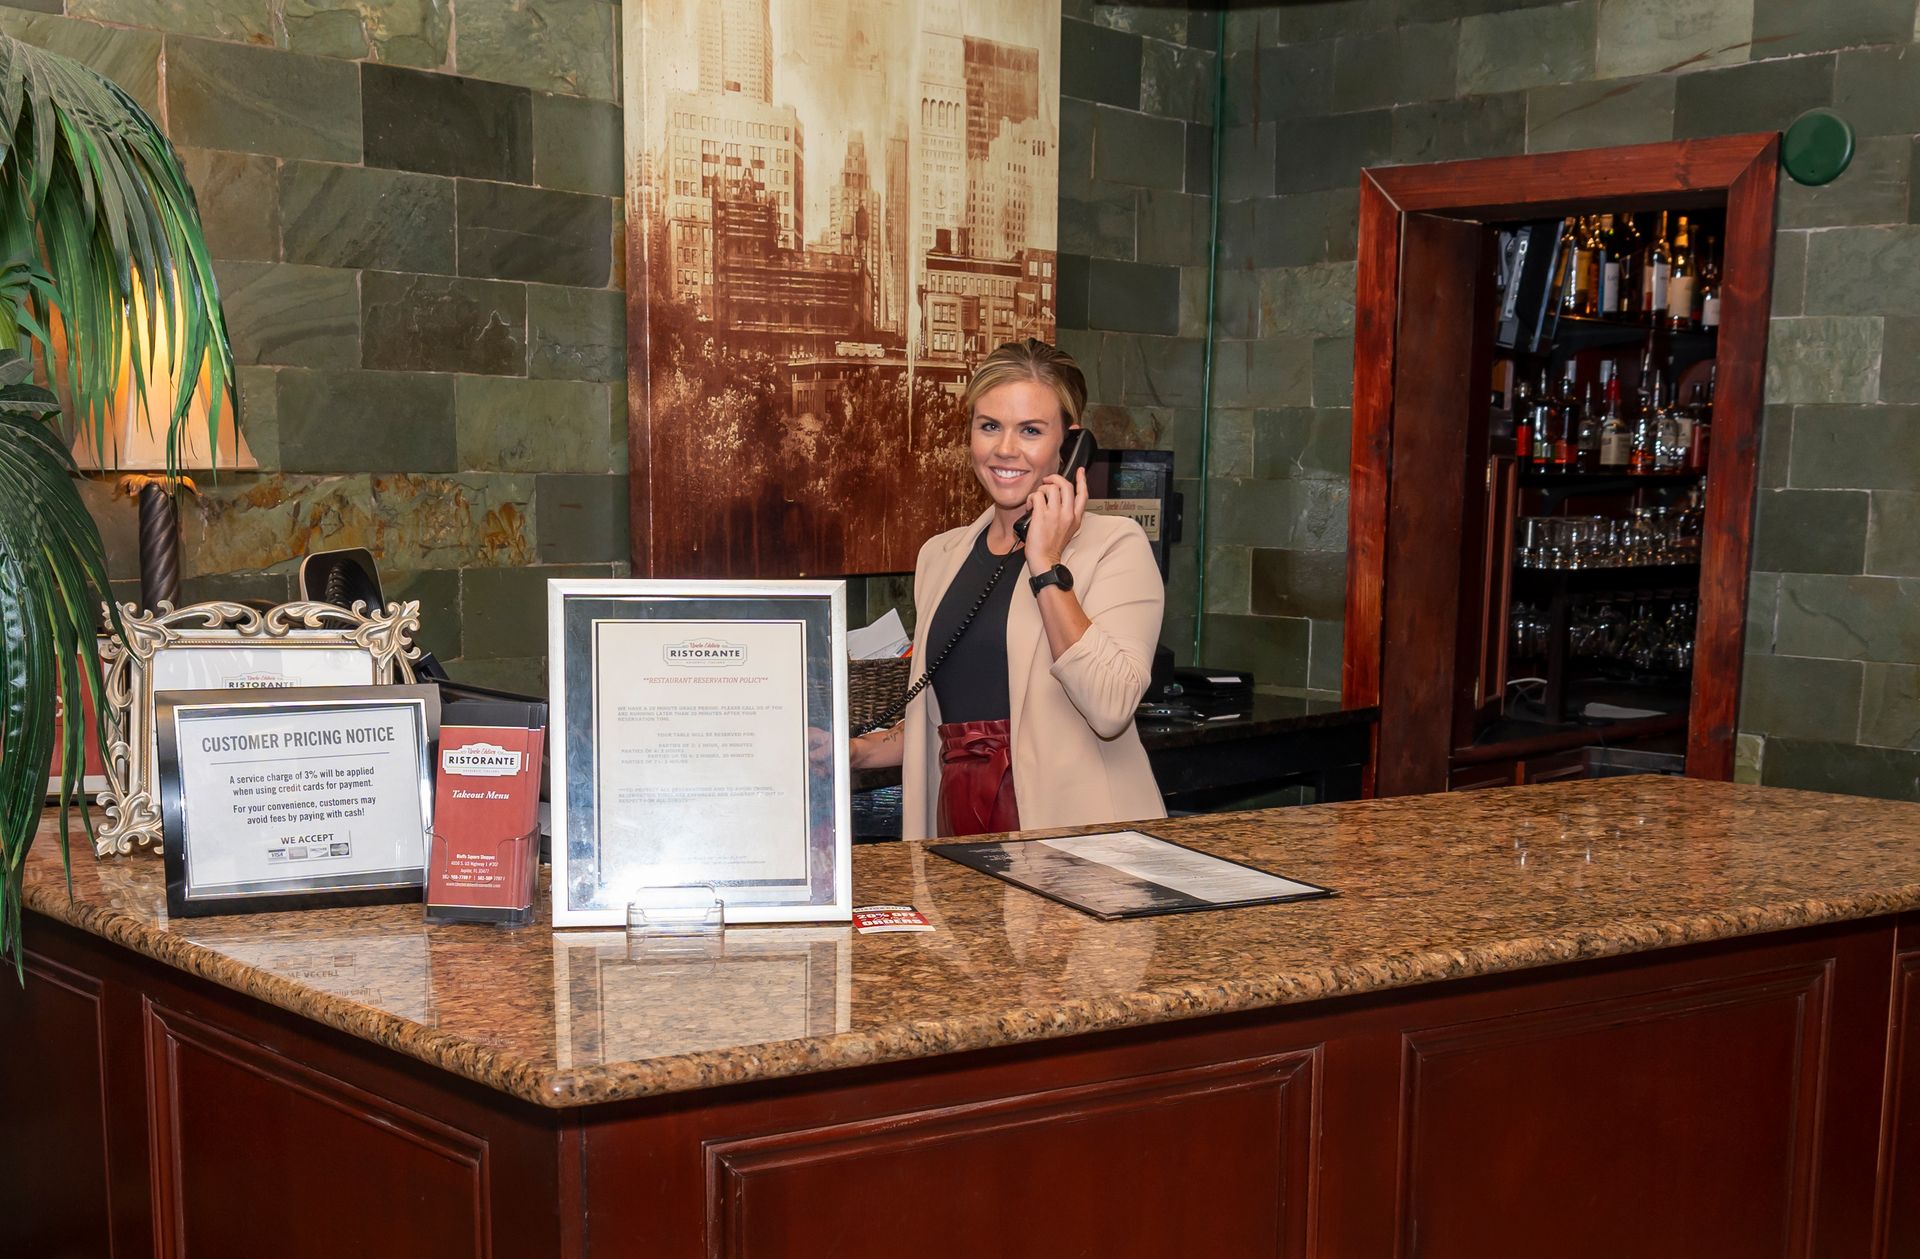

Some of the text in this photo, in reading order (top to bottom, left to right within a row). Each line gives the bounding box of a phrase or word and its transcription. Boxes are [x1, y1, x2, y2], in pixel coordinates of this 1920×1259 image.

[229, 681, 295, 689] RISTORANTE
[202, 727, 395, 752] CUSTOMER PRICING NOTICE
[448, 756, 515, 765] RISTORANTE
[230, 766, 375, 784] A service charge of 3% will be applied
[233, 779, 373, 796] when using credit cards for payment.
[452, 790, 510, 800] Takeout Menu
[233, 796, 376, 815] For your convenience, customers may
[247, 808, 365, 825] avoid fees by paying with cash!
[281, 833, 334, 845] WE ACCEPT
